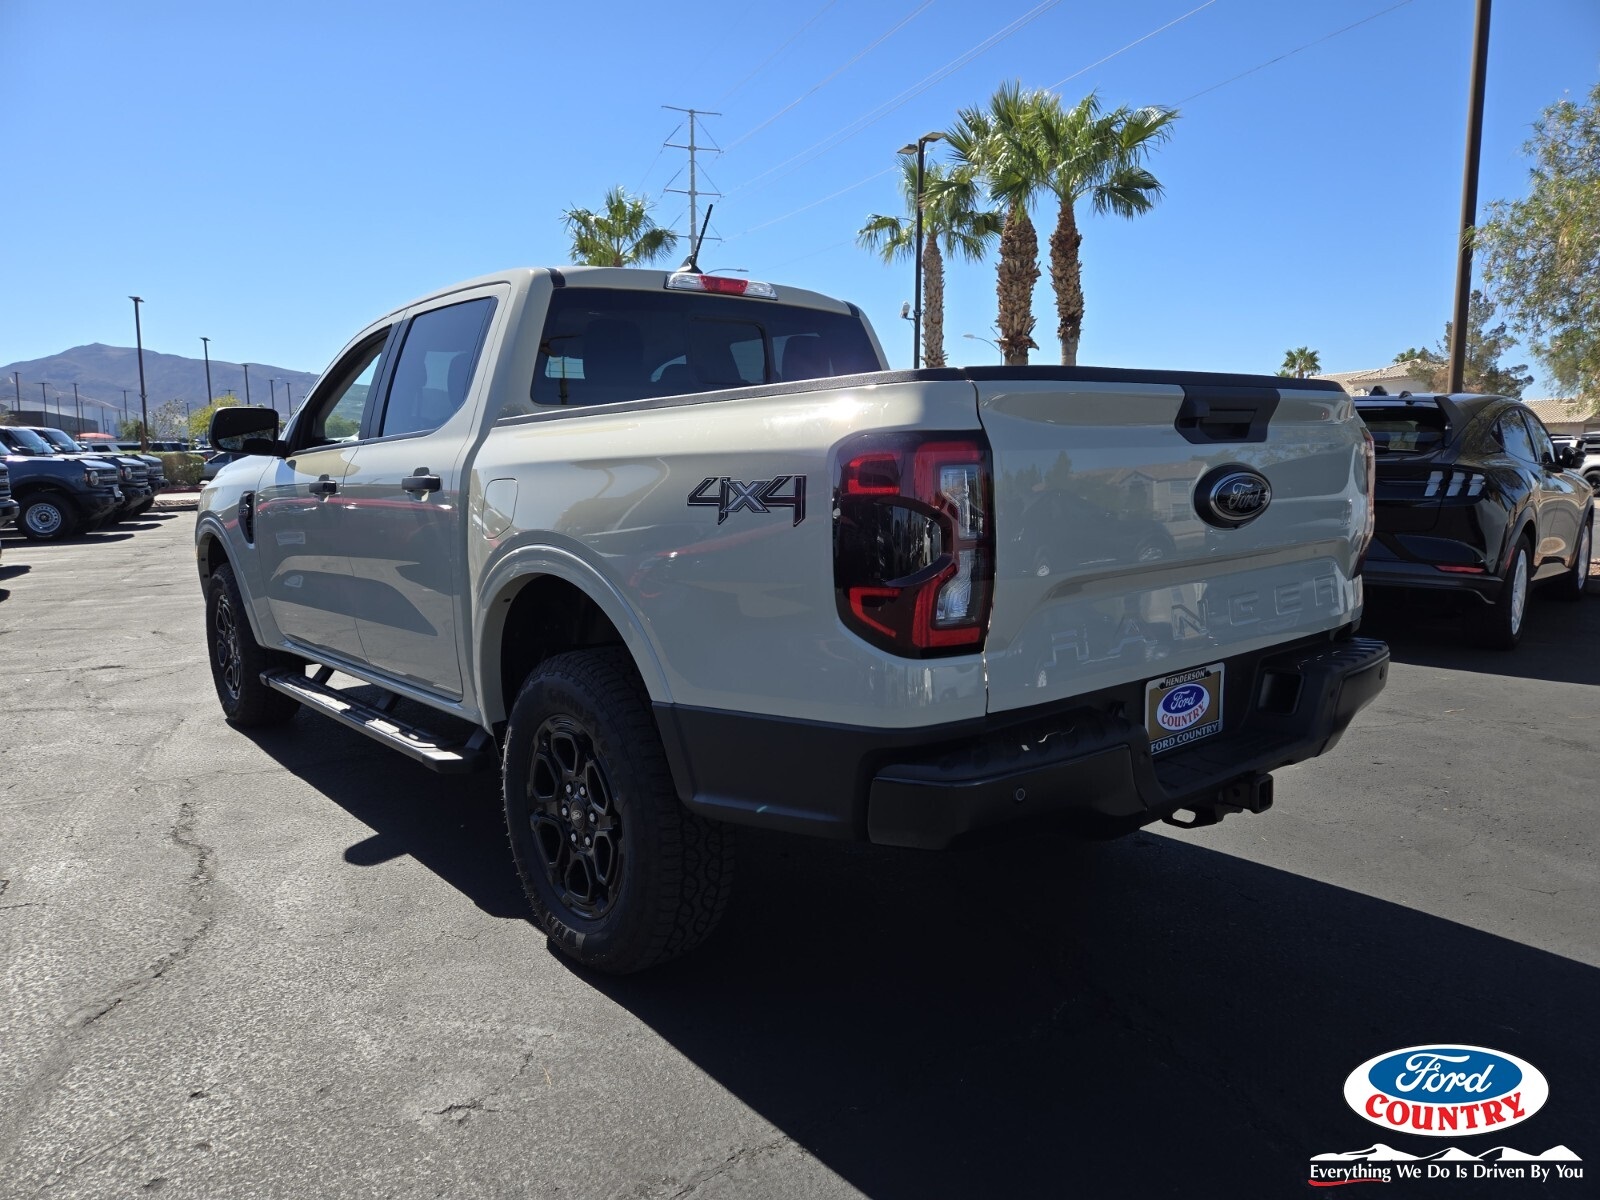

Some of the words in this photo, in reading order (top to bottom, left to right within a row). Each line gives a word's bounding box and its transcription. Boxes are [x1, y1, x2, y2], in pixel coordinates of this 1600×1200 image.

[1228, 483, 1261, 509] Ford
[1045, 574, 1345, 667] RANGER
[1165, 669, 1206, 687] HENDERSON
[1170, 690, 1196, 711] Ford
[1161, 701, 1205, 727] COUNTRY
[1150, 736, 1175, 753] FORD
[1176, 723, 1219, 743] COUNTRY
